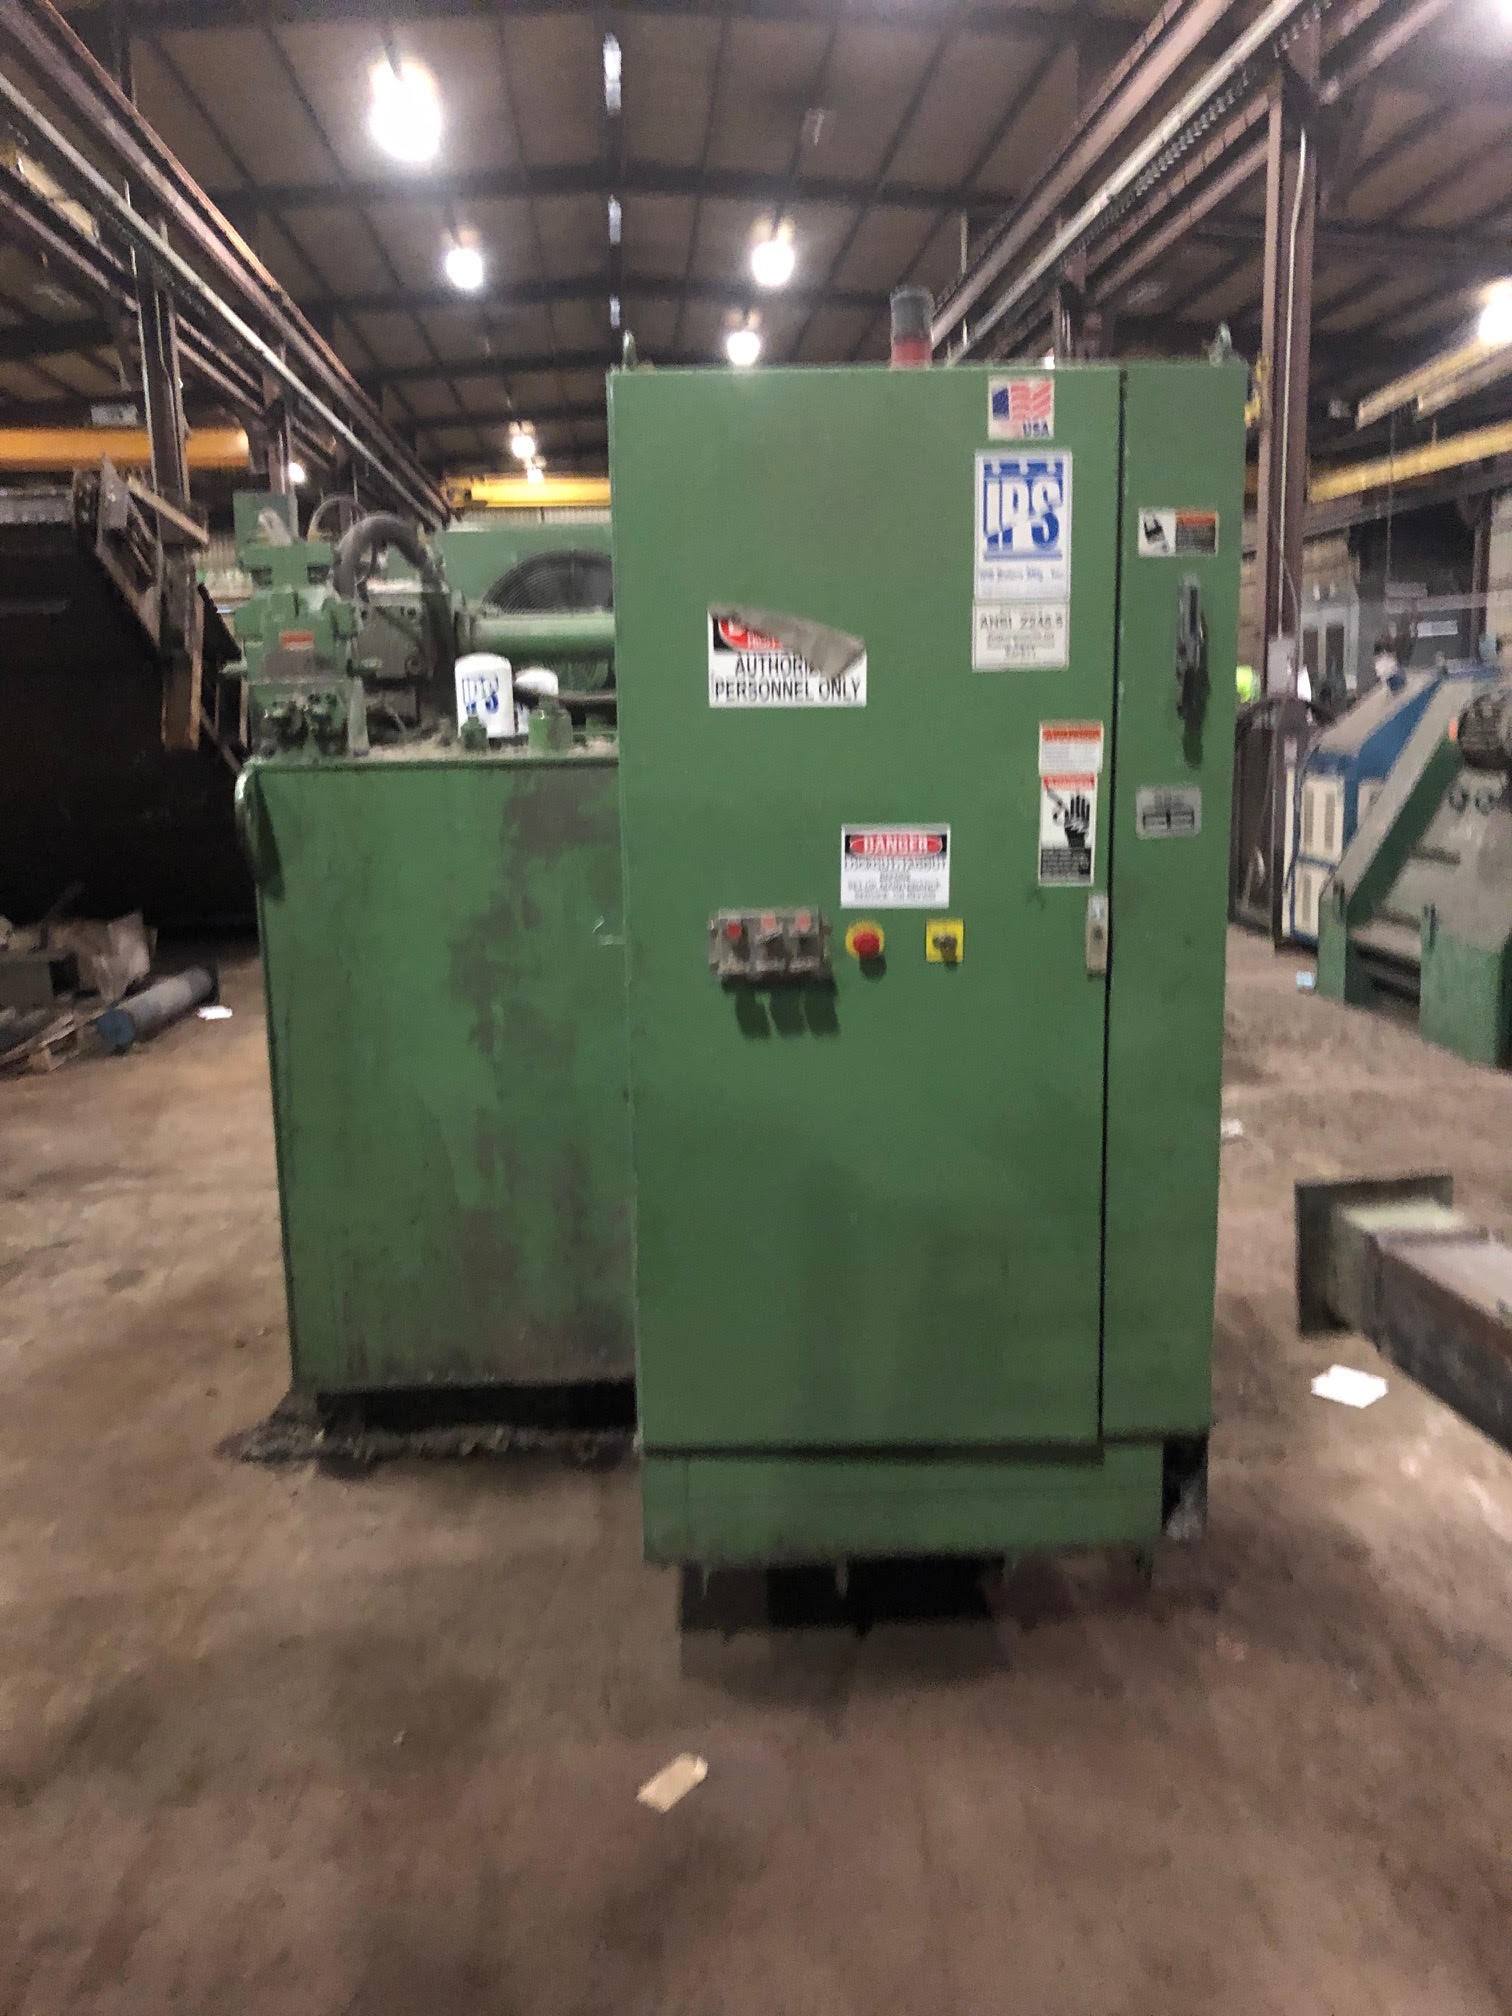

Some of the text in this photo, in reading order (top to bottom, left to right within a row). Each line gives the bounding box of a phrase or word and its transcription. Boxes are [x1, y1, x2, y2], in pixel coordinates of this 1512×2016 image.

[1022, 421, 1050, 438] USA
[984, 472, 1062, 553] IPS
[735, 652, 809, 676] AUTHORI
[714, 674, 861, 703] PERSONNEL ONLY
[863, 833, 928, 855] DANGER
